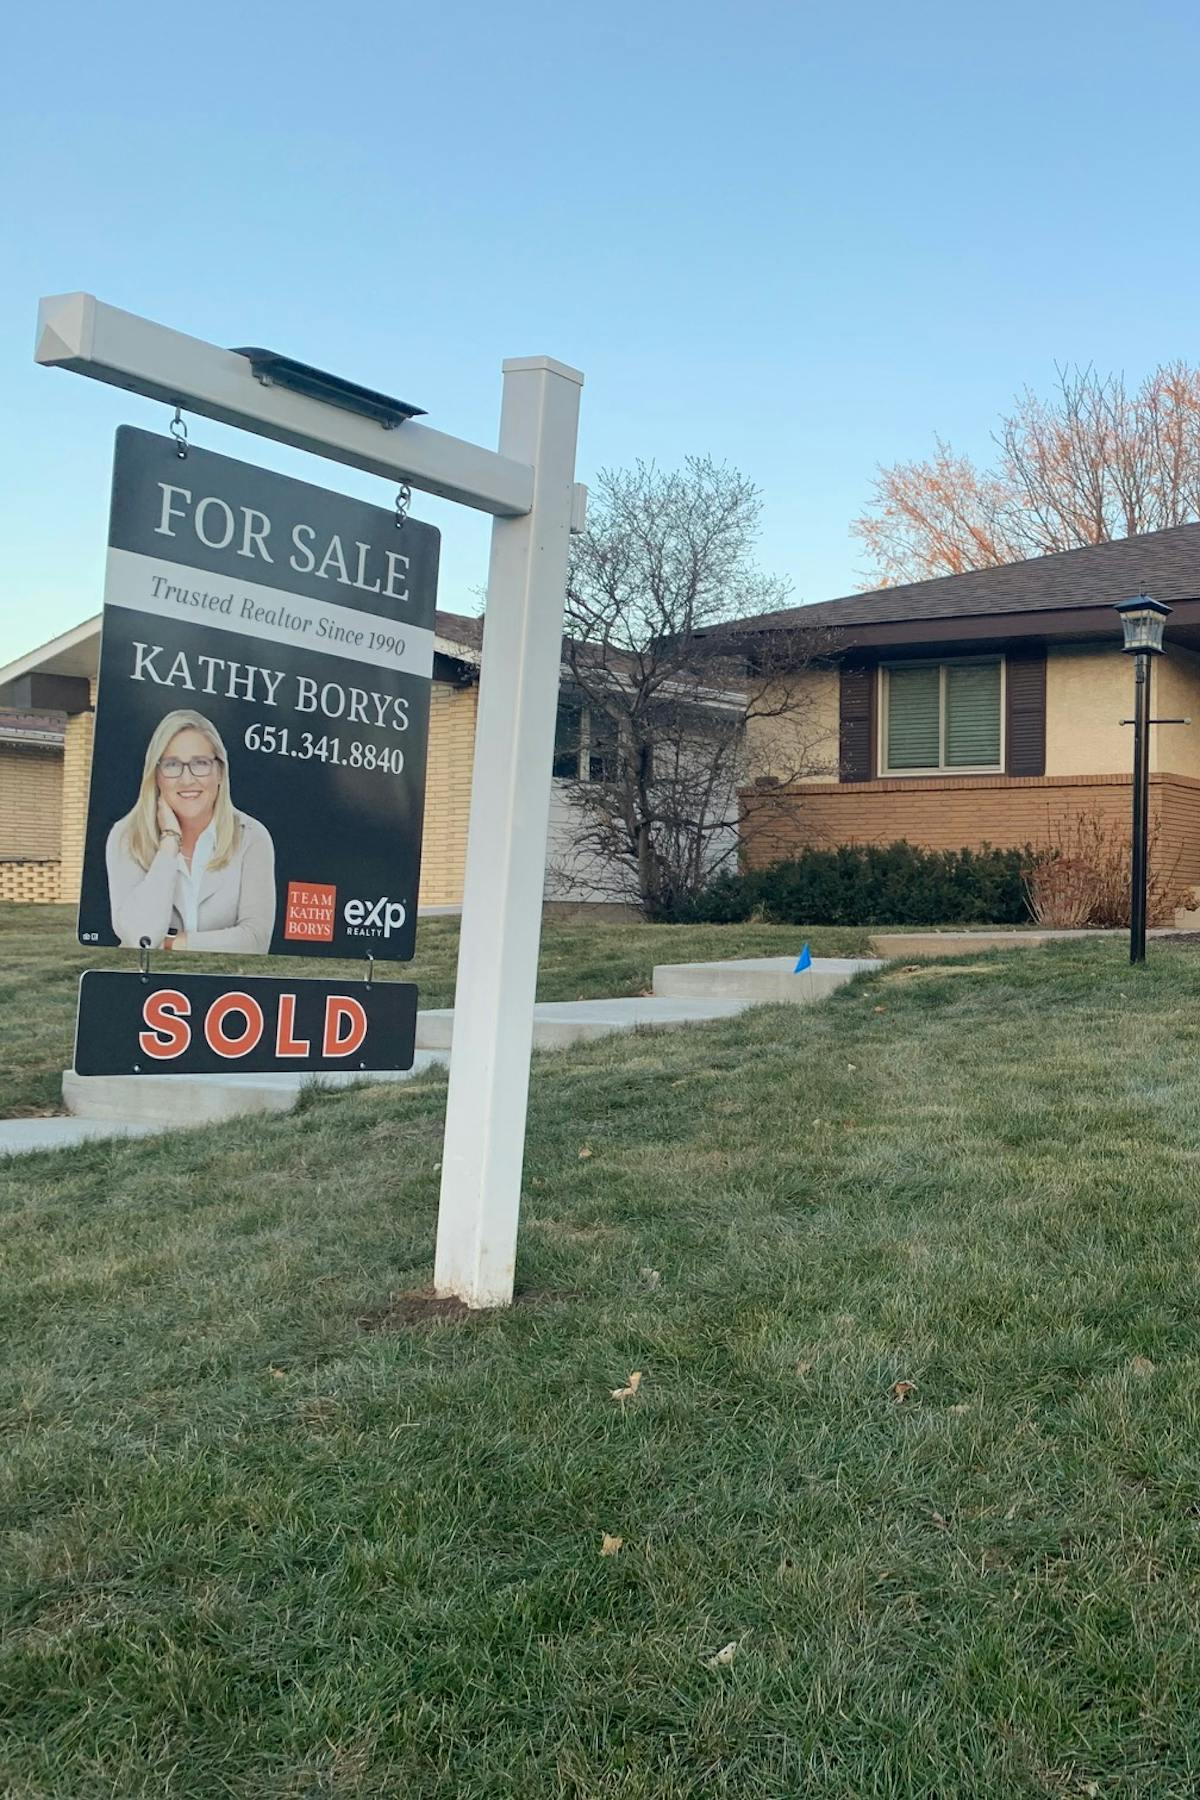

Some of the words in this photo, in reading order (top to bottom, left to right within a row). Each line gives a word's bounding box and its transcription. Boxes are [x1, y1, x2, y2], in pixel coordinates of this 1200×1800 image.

[154, 482, 274, 563] FOR
[290, 524, 410, 601] SALE
[150, 576, 234, 614] Trusted
[240, 598, 313, 632] Realtor
[315, 617, 364, 646] Since
[367, 632, 406, 656] 1990
[129, 641, 286, 706] KATHY
[295, 675, 409, 731] BORYS
[244, 723, 404, 775] 651.341.8840
[289, 907, 333, 920] KATHY
[290, 891, 332, 906] TEAM
[288, 922, 331, 936] BORYS
[346, 927, 382, 937] REALTY
[138, 989, 368, 1060] SOLD
